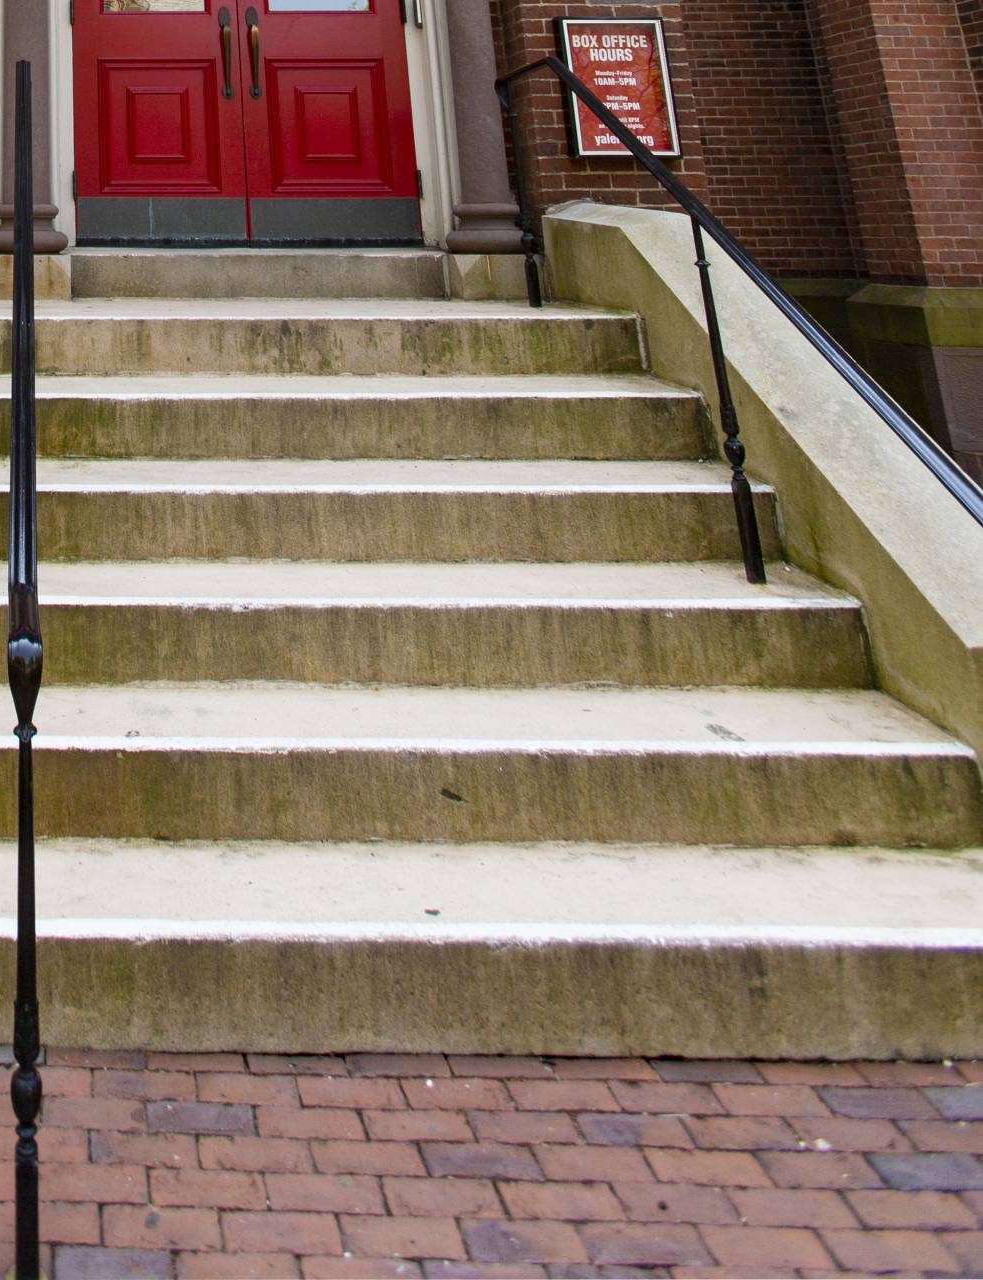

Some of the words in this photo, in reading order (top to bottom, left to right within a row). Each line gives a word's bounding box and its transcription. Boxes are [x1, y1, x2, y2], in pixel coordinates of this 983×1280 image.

[571, 35, 599, 48] BOX
[602, 35, 648, 48] OFFICE
[590, 48, 633, 61] HOURS
[602, 102, 640, 110] PM-5PM
